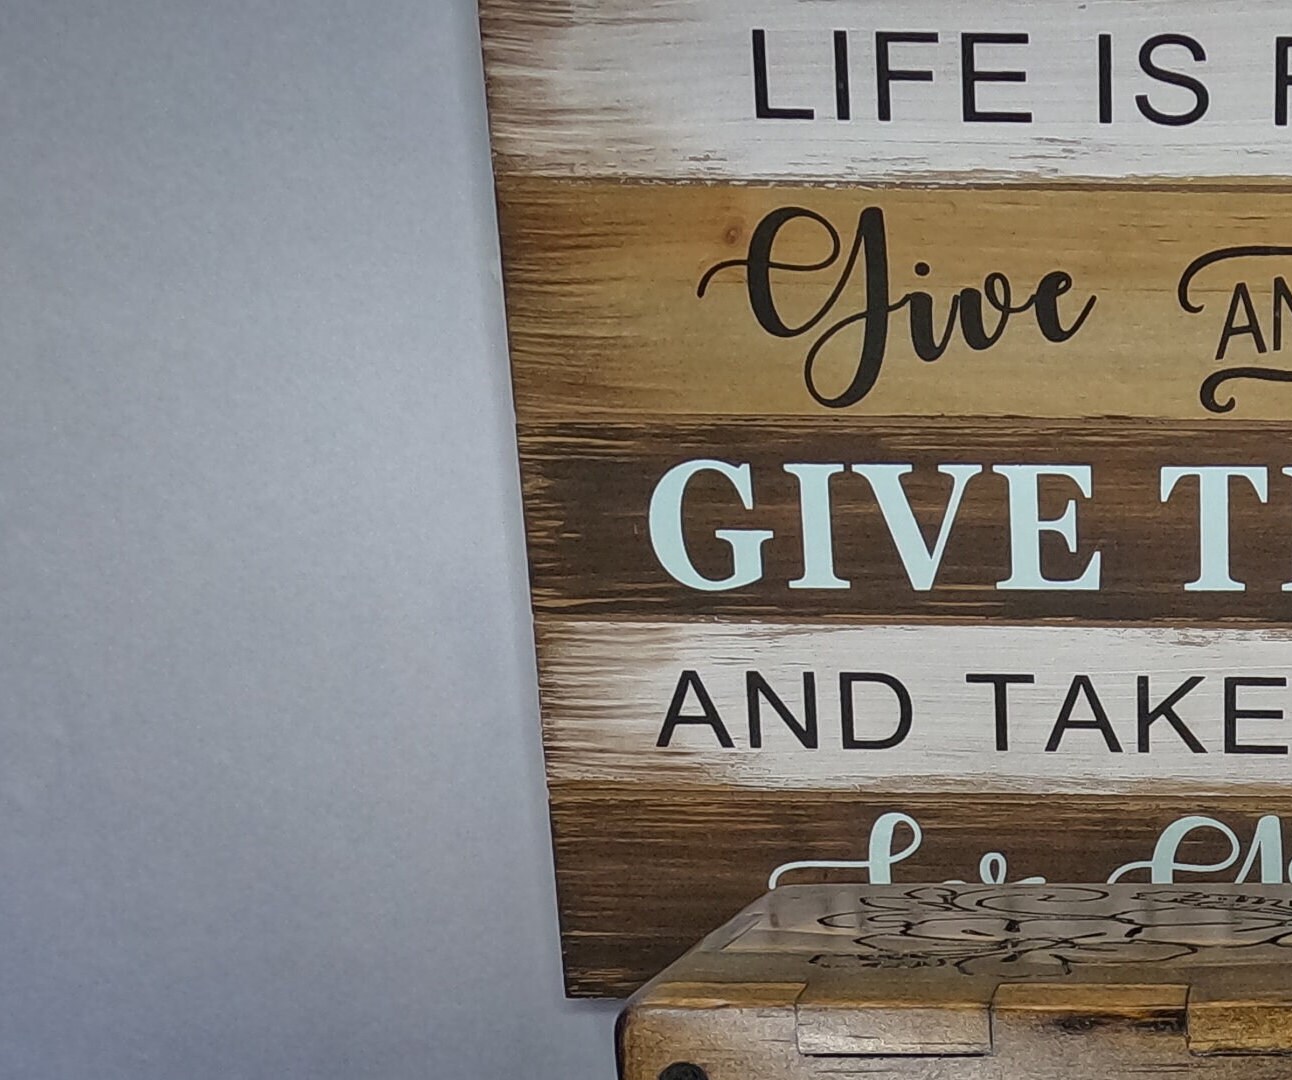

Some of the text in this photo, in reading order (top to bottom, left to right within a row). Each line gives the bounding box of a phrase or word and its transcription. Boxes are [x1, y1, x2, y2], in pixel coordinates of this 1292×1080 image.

[753, 30, 1033, 123] LIFE
[1098, 33, 1210, 127] IS
[697, 206, 1097, 408] Give
[648, 459, 1101, 591] GIVE
[655, 670, 913, 750] AND
[965, 673, 1289, 755] TAKE
